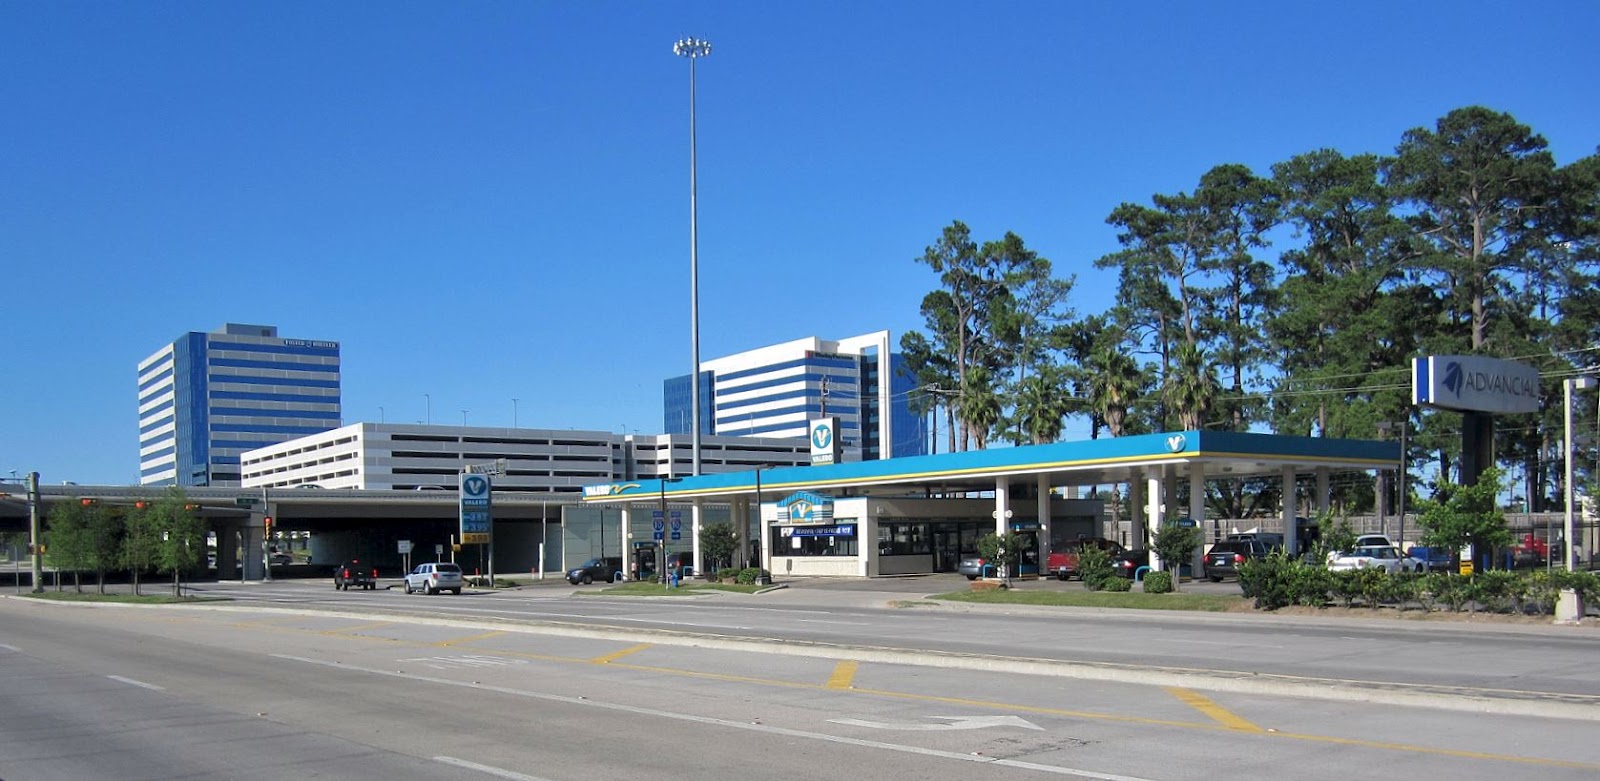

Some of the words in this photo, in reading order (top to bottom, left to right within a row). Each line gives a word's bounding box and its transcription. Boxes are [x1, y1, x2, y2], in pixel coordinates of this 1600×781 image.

[1465, 372, 1537, 397] ADVANCIAL
[815, 428, 829, 447] V
[467, 480, 482, 494] V
[654, 521, 662, 529] 10
